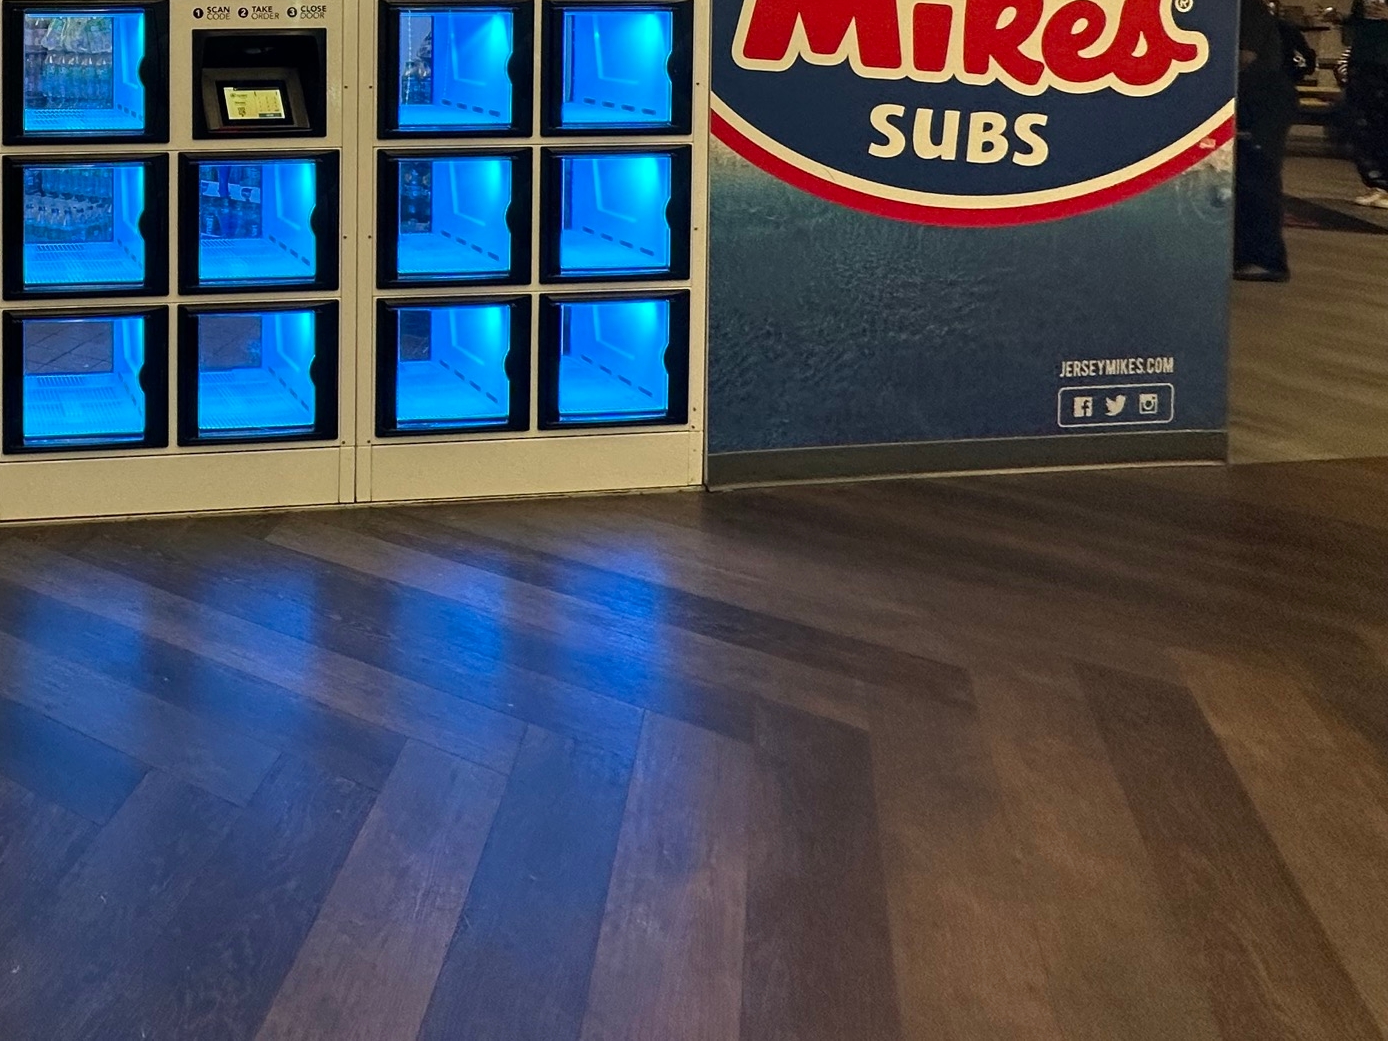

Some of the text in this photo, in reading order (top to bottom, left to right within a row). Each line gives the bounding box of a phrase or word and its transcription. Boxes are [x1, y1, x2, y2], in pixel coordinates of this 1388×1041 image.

[301, 5, 327, 13] CLOSE
[207, 12, 231, 20] CODE
[251, 12, 280, 20] ORDER
[300, 11, 325, 19] DOOR
[868, 103, 1049, 167] SUBS
[1058, 356, 1175, 378] JERSEYMIKES.COM
